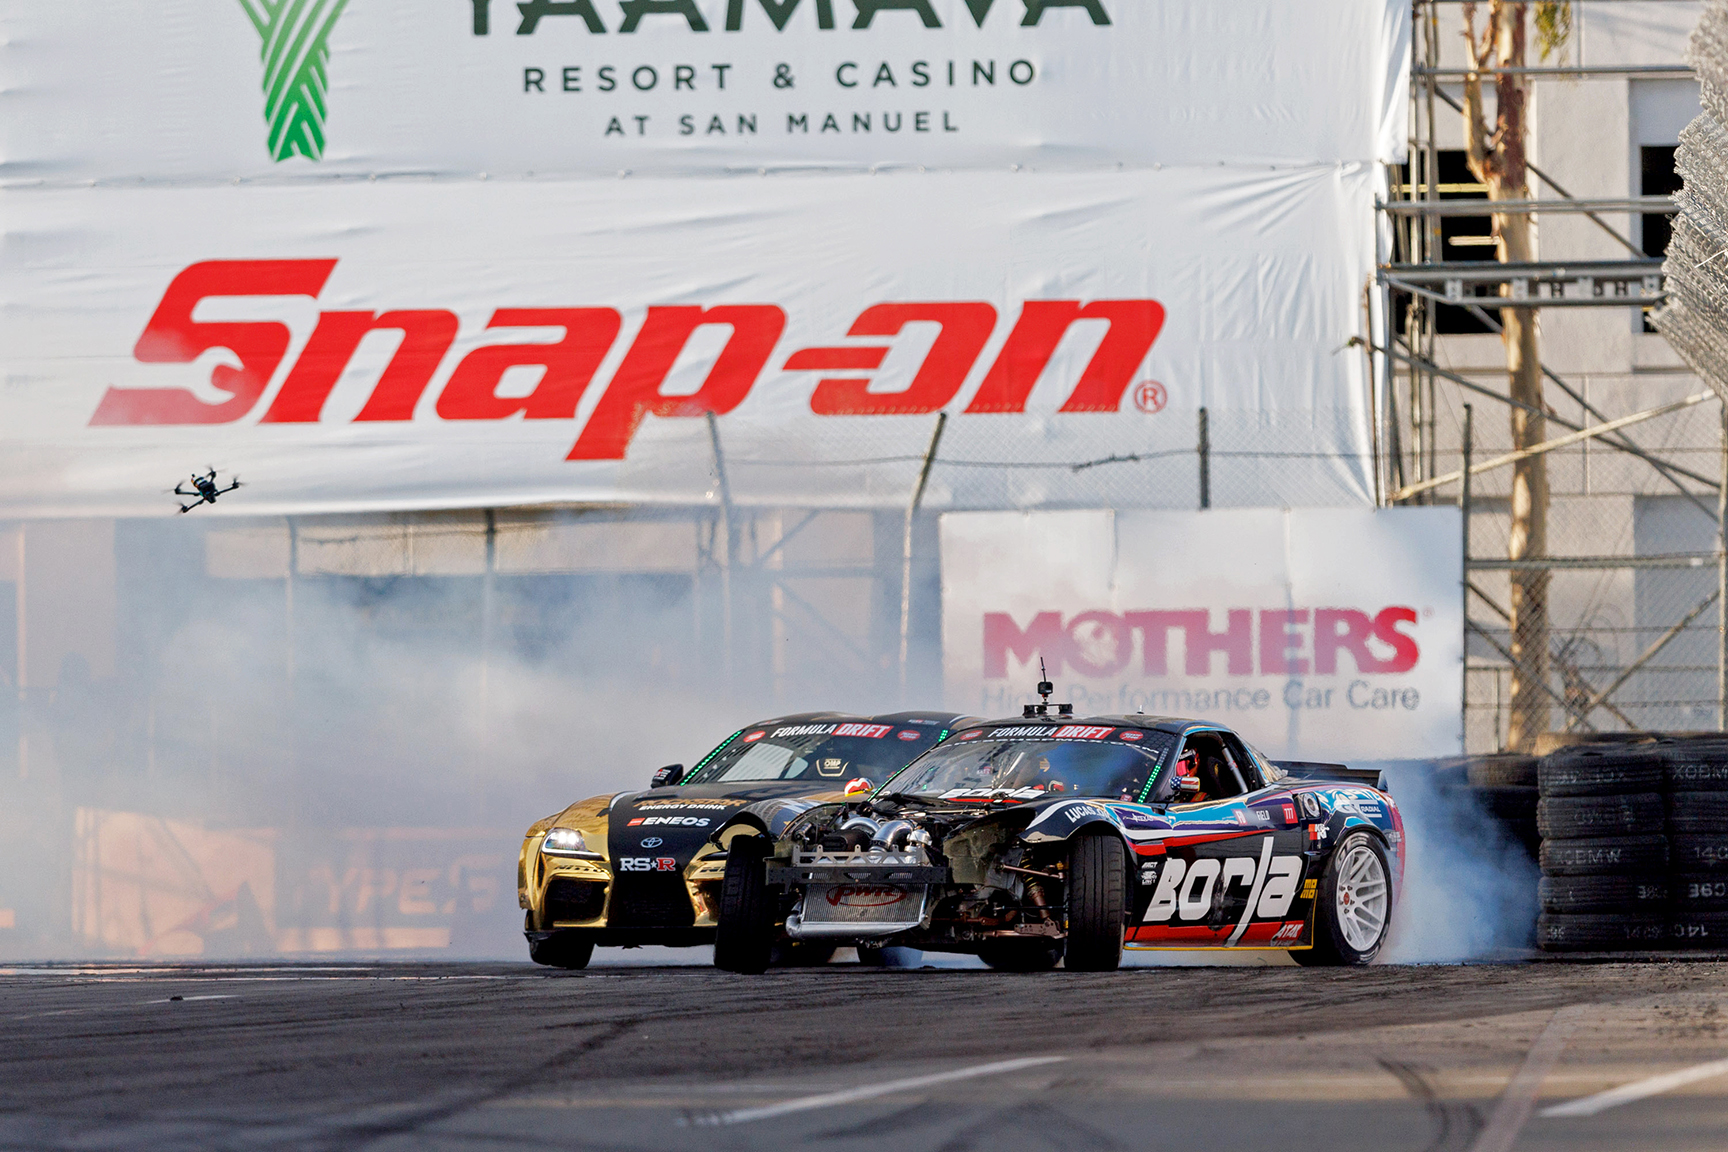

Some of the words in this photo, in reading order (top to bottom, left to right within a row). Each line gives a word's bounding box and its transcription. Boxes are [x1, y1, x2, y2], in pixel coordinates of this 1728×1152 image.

[523, 63, 733, 93] RESORT
[772, 62, 796, 90] &
[834, 58, 1035, 88] CASINO
[604, 116, 649, 136] AT
[679, 115, 757, 136] SAN
[786, 111, 958, 134] MANUEL
[90, 257, 1165, 461] Snap-on
[982, 604, 1420, 679] MOTHERS
[982, 685, 1053, 713] Hig
[1067, 682, 1271, 712] Performance
[1283, 680, 1335, 711] Car
[1347, 680, 1420, 711] Care
[770, 723, 838, 739] FORMULA
[837, 724, 892, 738] DRIFT
[987, 726, 1058, 738] FORMULA
[1058, 725, 1114, 739] DRIFT
[1064, 805, 1096, 824] LUCAS
[1283, 807, 1295, 820] 777
[1359, 805, 1382, 813] RADIAL
[641, 816, 711, 827] ENEOS
